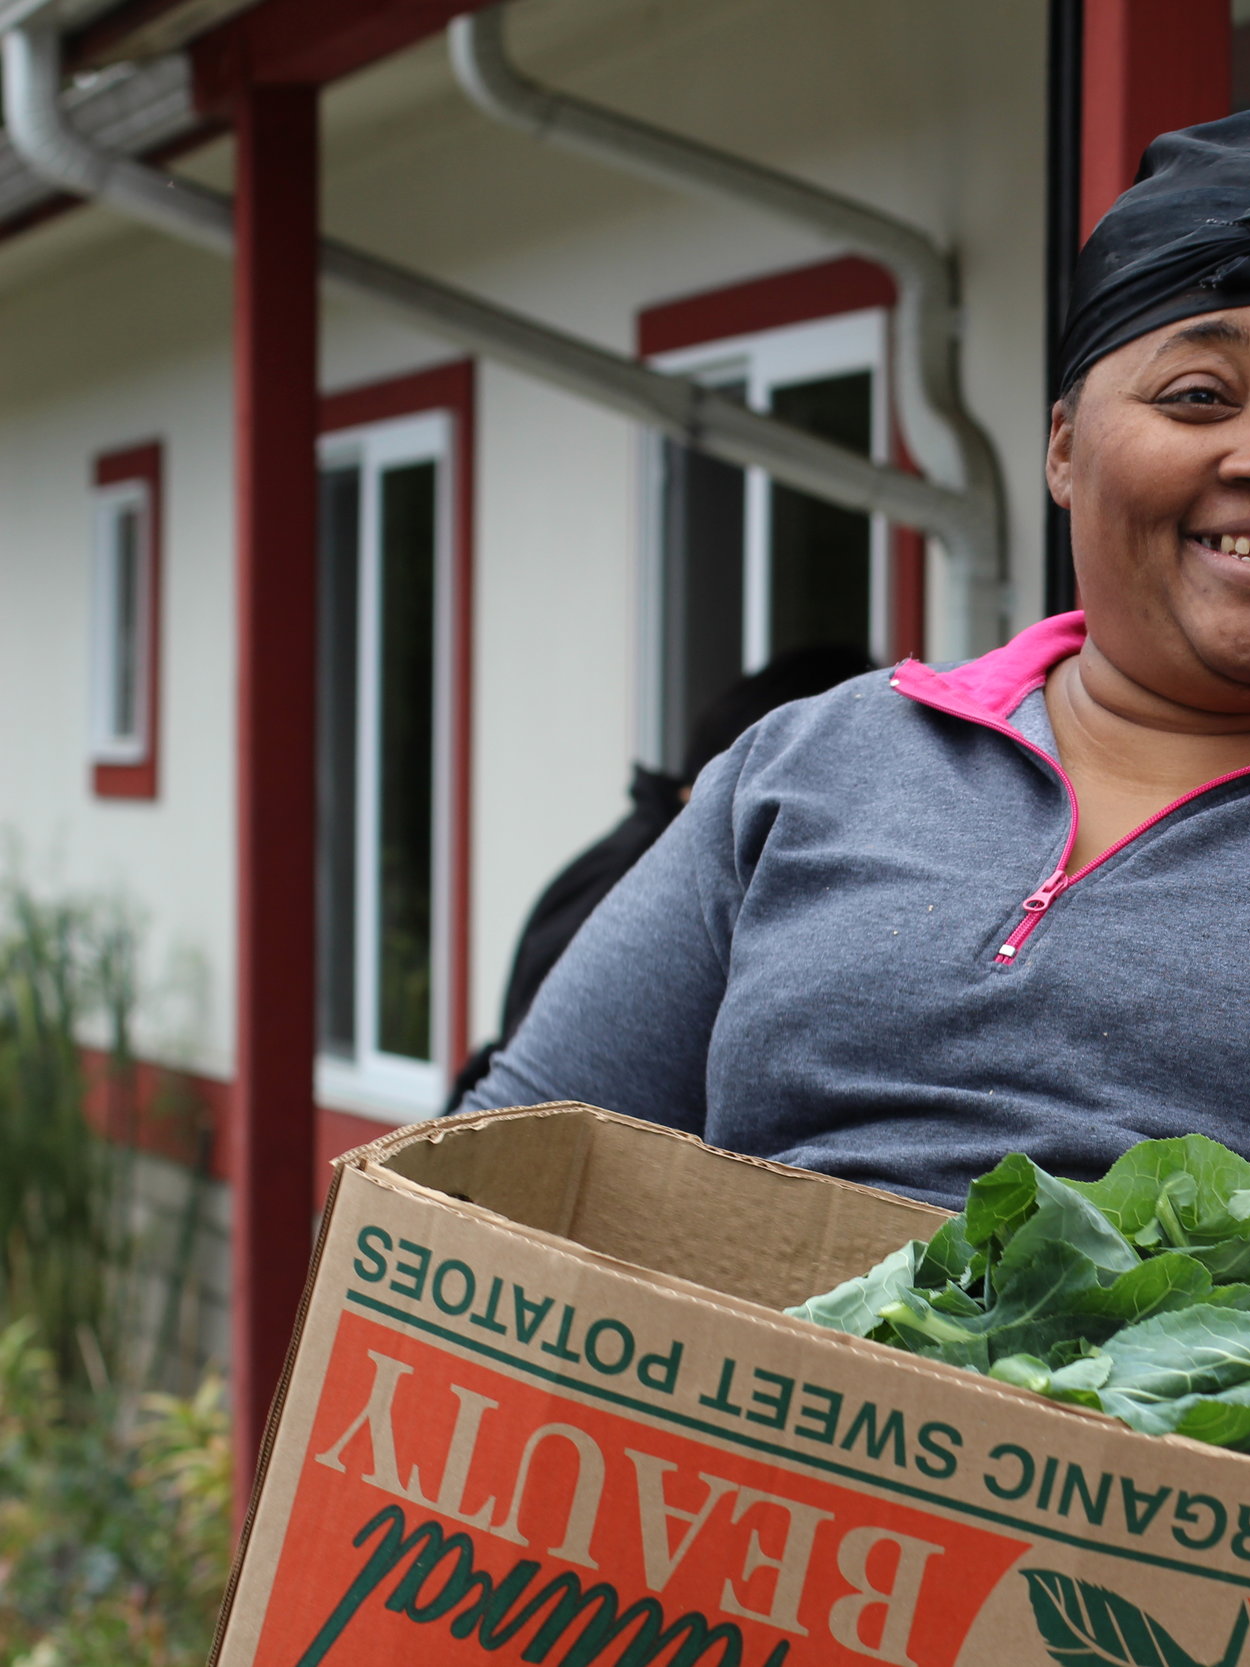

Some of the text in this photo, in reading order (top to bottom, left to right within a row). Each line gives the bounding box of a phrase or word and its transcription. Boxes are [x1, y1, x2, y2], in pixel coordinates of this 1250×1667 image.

[353, 1225, 684, 1395] POTATOES
[698, 1357, 963, 1479] SWEET
[297, 1503, 791, 1667] ural
[314, 1348, 946, 1667] BEAUTY
